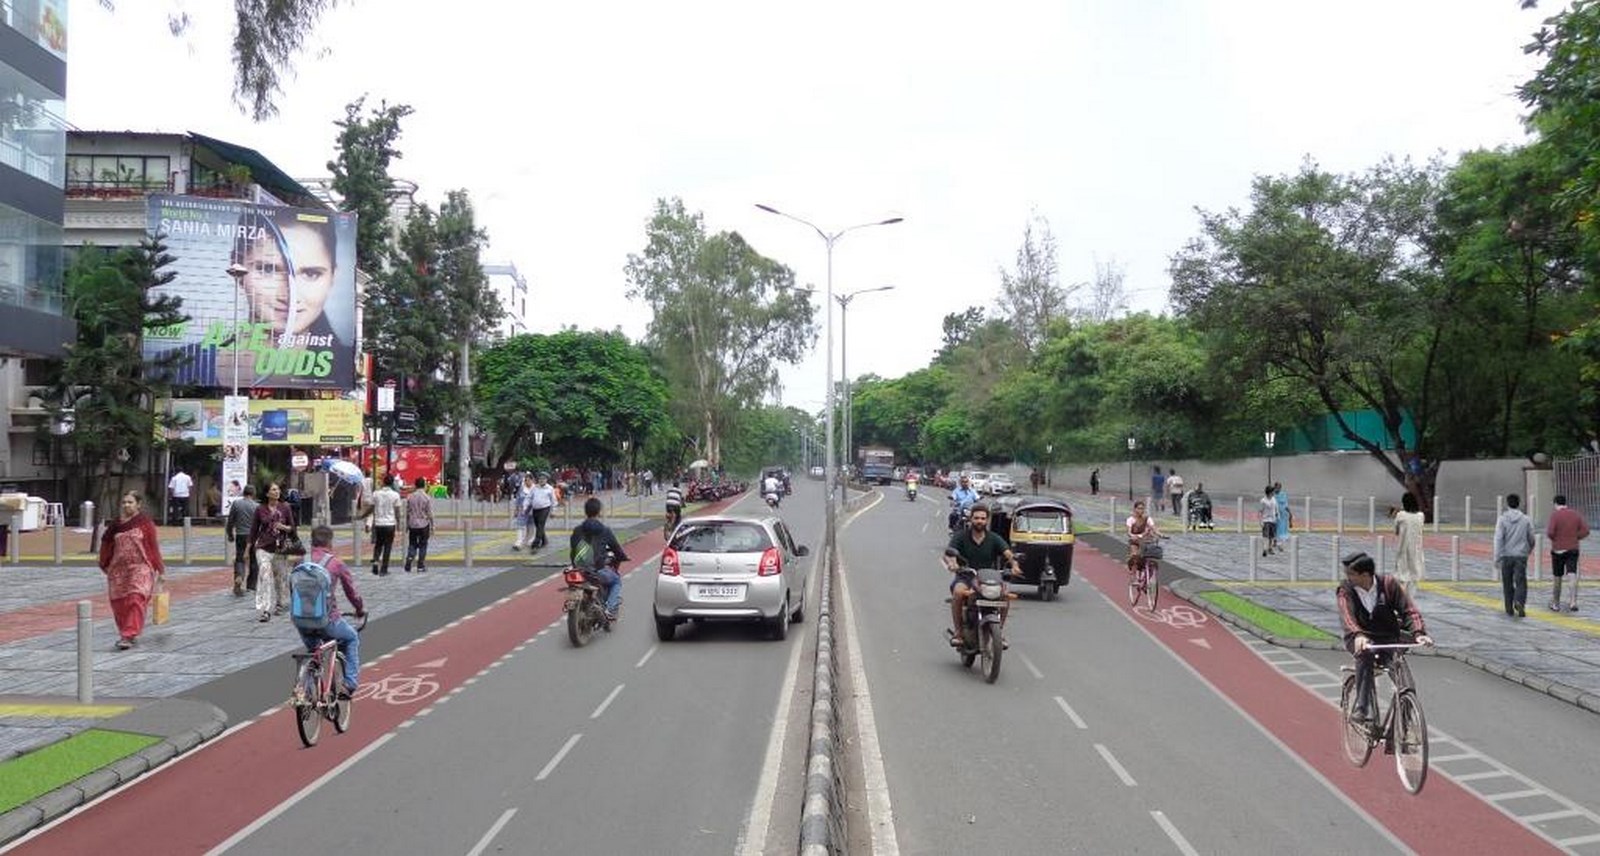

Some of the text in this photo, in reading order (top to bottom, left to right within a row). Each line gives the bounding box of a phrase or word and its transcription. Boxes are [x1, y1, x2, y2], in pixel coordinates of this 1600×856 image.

[161, 218, 267, 240] SANIA MIRZA
[148, 326, 182, 337] NOW
[201, 320, 275, 351] ACE
[277, 332, 334, 349] against
[255, 348, 335, 378] ODDS
